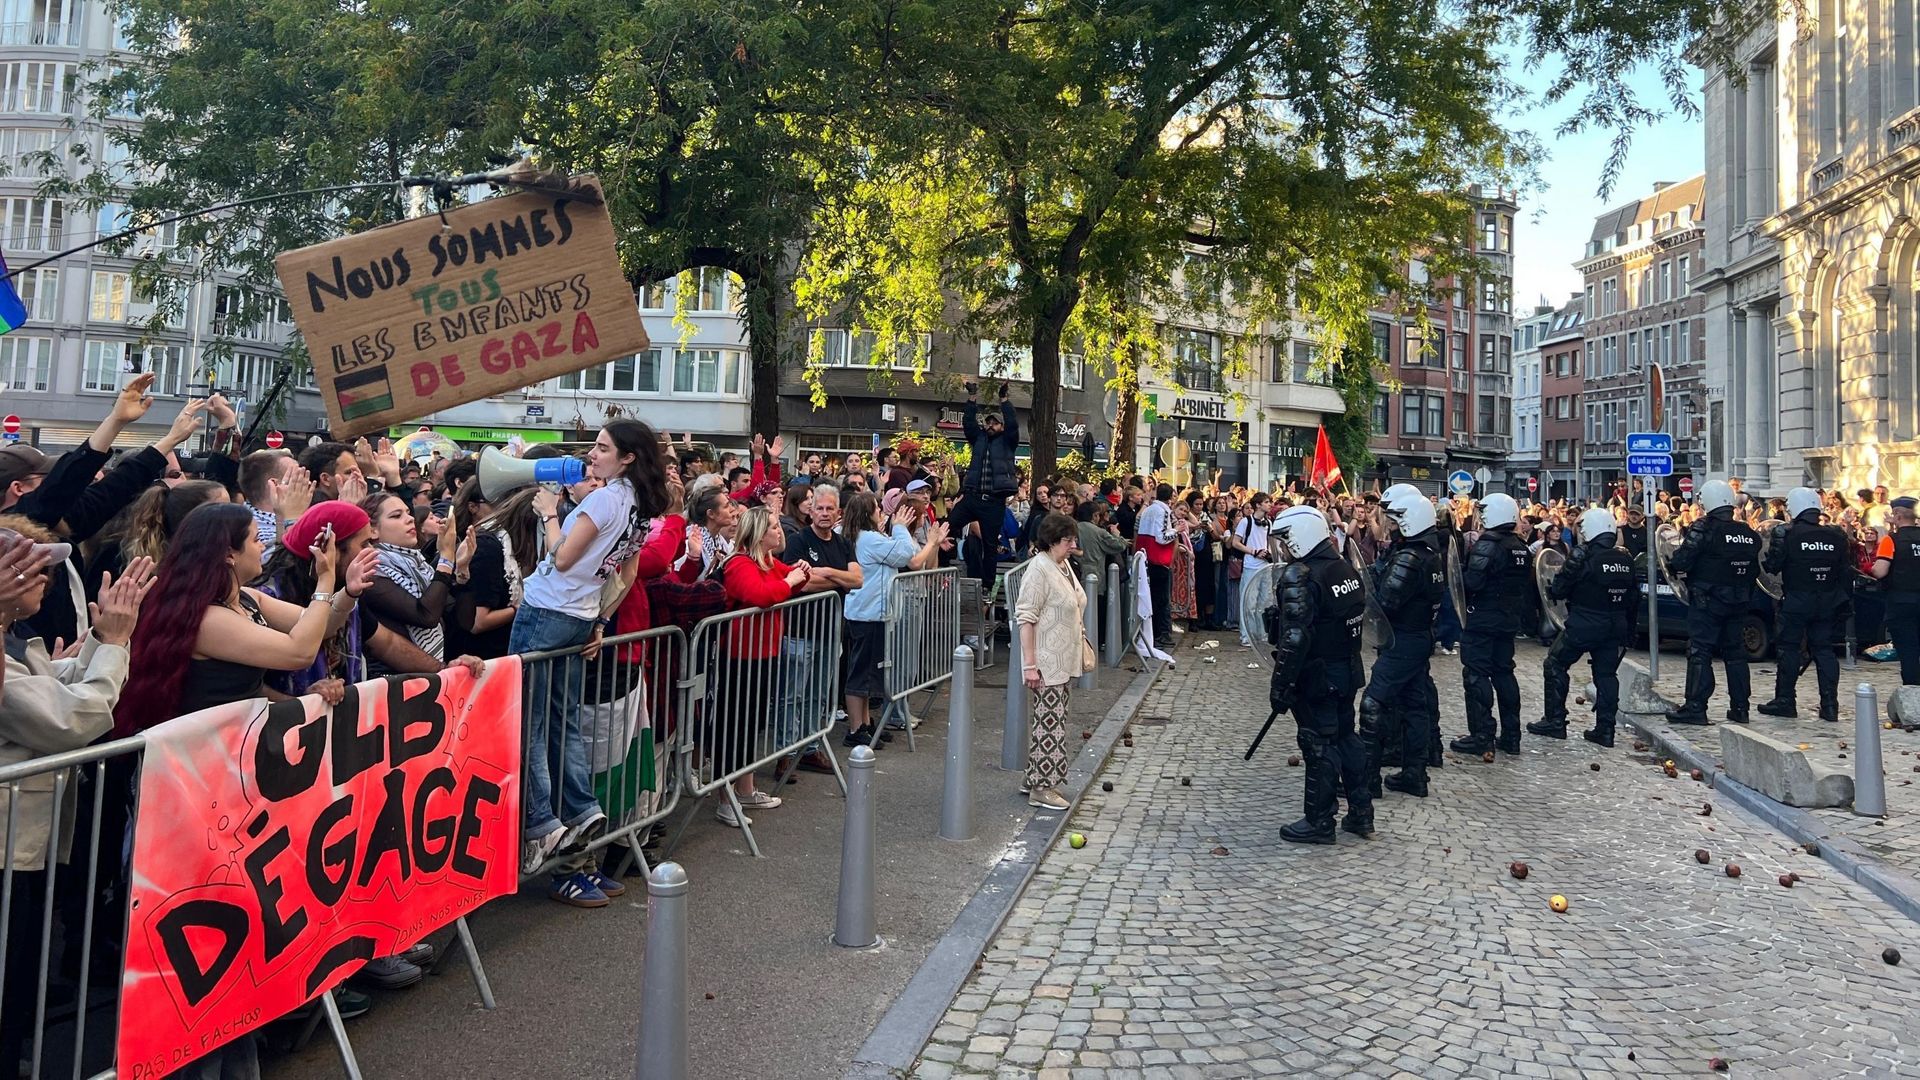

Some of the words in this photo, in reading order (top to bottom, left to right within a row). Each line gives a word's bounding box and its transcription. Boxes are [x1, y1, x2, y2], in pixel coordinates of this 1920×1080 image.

[306, 247, 411, 313] NOUS
[428, 199, 573, 277] SOMMES
[413, 268, 500, 316] TOUS
[331, 327, 395, 374] LES
[414, 273, 590, 352] ENFANTS
[410, 355, 466, 397] DE
[480, 311, 599, 375] GAZA
[1058, 422, 1086, 440] Delft
[1152, 436, 1226, 453] ATATION
[1725, 534, 1754, 545] Police
[1801, 541, 1835, 551] Police
[1331, 579, 1360, 597] Police
[1602, 563, 1630, 573] Police
[254, 672, 446, 802] GLB
[155, 767, 501, 1007] DÉGAGE
[132, 1053, 165, 1080] PAS
[172, 1044, 192, 1064] DE
[430, 904, 450, 922] NOS
[456, 892, 483, 907] UNIFS
